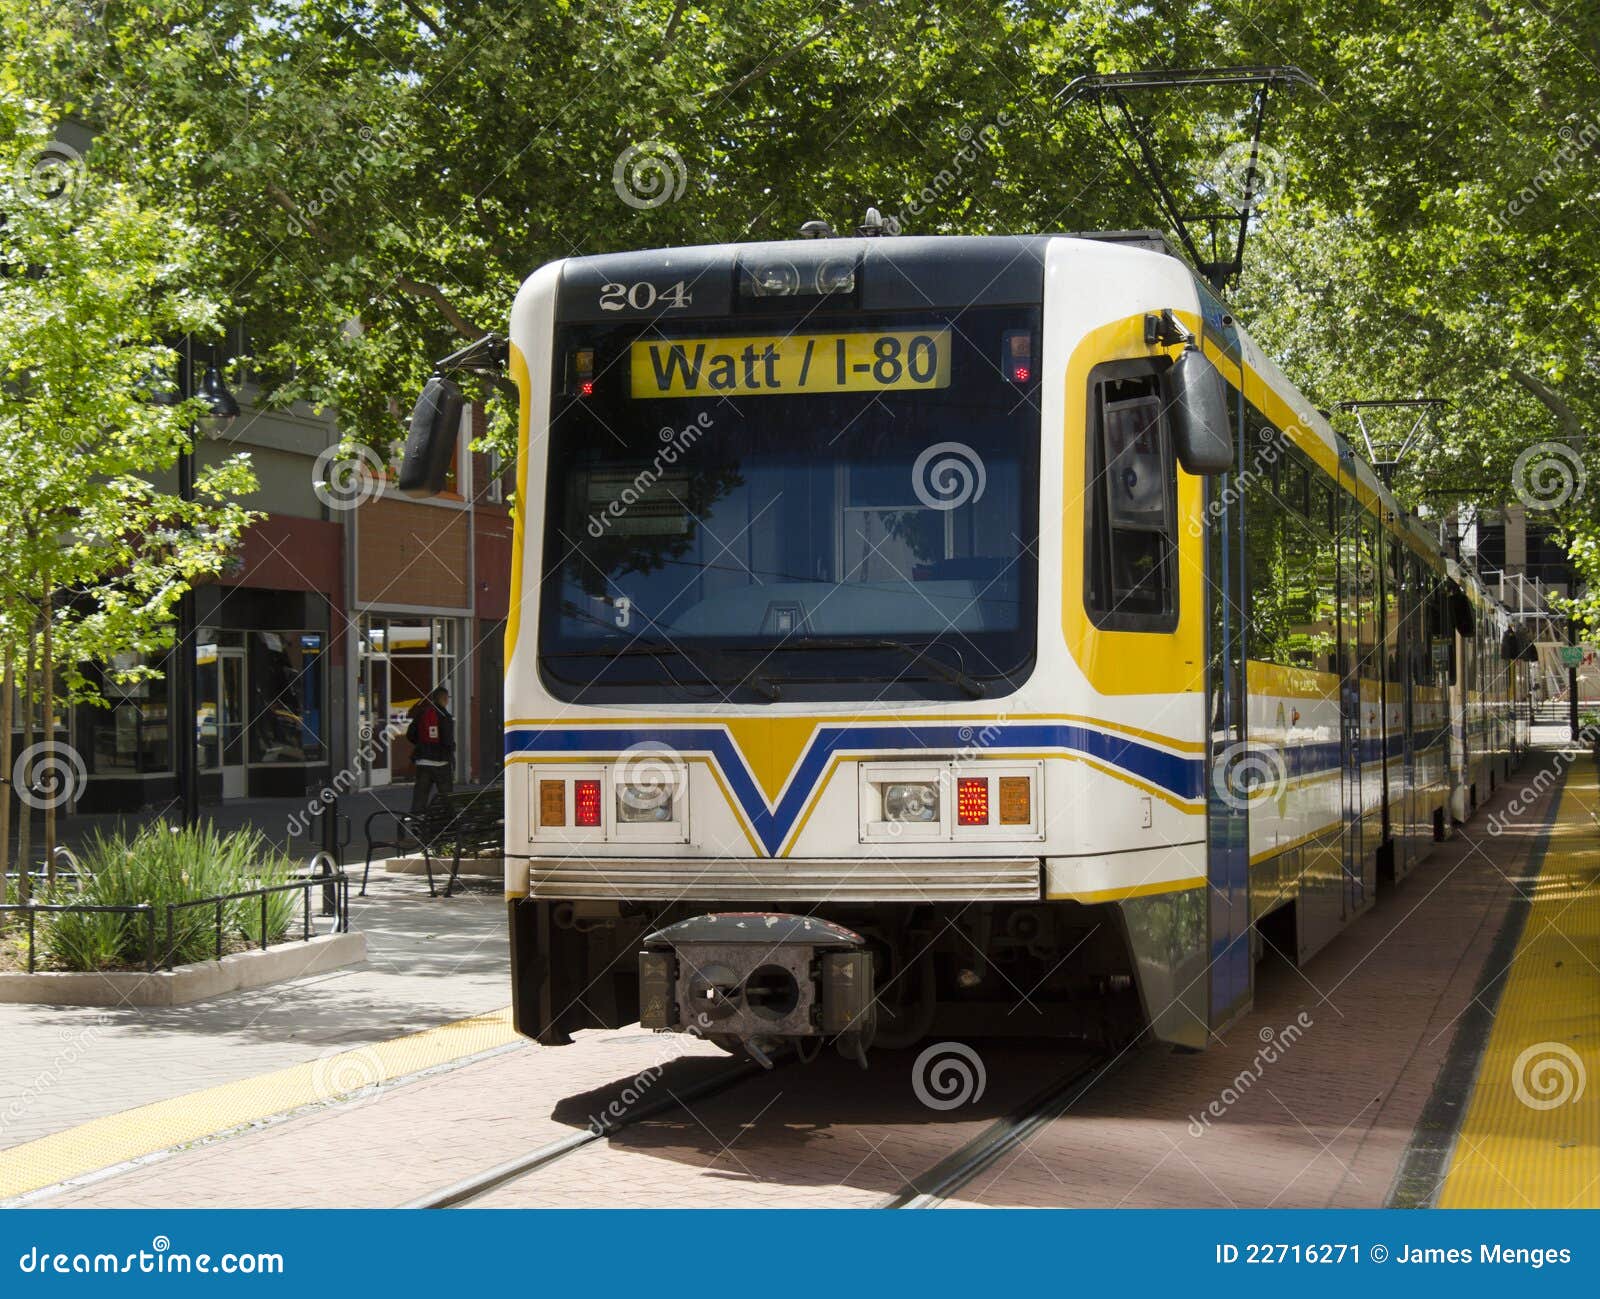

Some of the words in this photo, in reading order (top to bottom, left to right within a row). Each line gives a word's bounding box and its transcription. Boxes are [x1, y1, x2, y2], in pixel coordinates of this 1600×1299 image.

[599, 280, 693, 311] 204
[648, 342, 781, 392] Watt
[797, 339, 816, 387] /
[835, 334, 938, 386] I-80
[614, 596, 631, 628] 3
